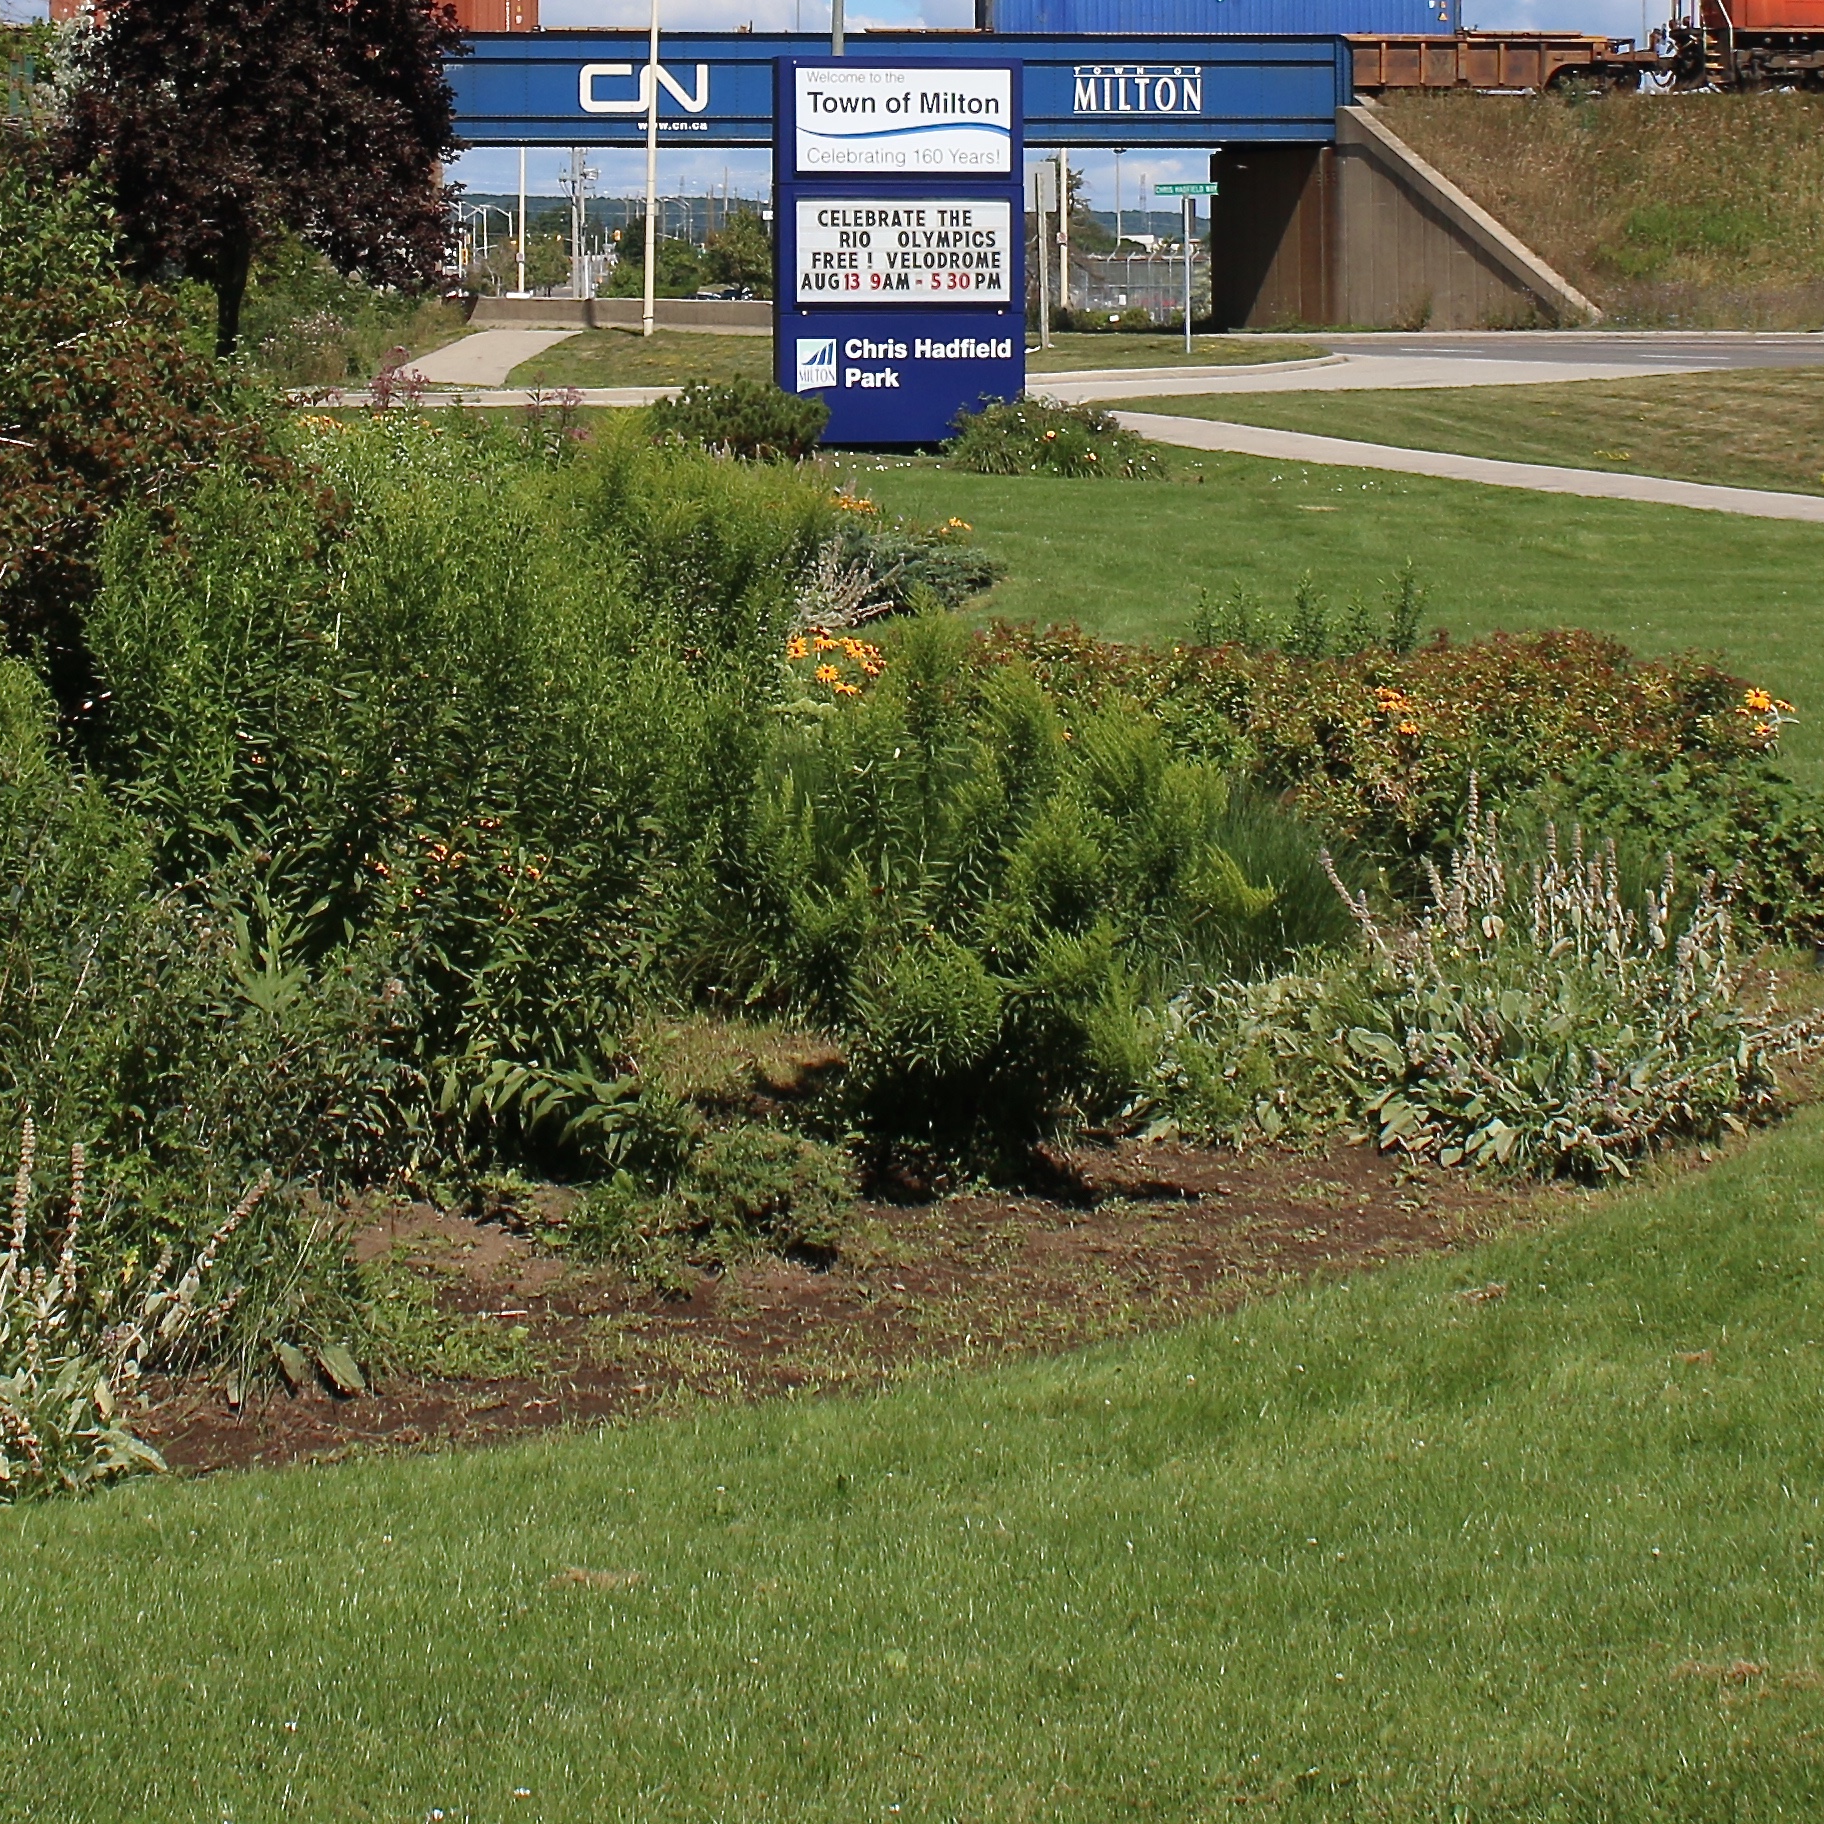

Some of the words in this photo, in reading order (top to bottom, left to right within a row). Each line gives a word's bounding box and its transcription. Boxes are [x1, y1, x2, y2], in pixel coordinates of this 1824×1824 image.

[807, 71, 866, 84] Welcome
[869, 72, 882, 84] to
[885, 72, 905, 84] the
[1073, 66, 1144, 75] TOWN
[1173, 66, 1202, 75] OF
[579, 63, 709, 113] CN
[1073, 77, 1202, 112] MILTON
[807, 91, 876, 114] Town
[885, 91, 911, 114] of
[920, 92, 1000, 114] Milton
[637, 122, 708, 131] ww.cn.ca
[806, 147, 906, 167] Celebrating
[914, 149, 944, 165] 160
[948, 148, 1000, 165] Years!
[817, 209, 926, 227] CELEBRATE
[937, 209, 973, 227] THE
[839, 230, 871, 248] RIO
[897, 230, 996, 248] OLYMPICS
[811, 251, 859, 269] FREE
[886, 251, 1001, 269] VELODROME
[801, 272, 840, 290] AUG
[843, 272, 861, 291] 13
[870, 272, 911, 291] 9AM
[975, 273, 1002, 291] PM
[844, 338, 908, 360] Chris
[914, 338, 1012, 360] Hadfield
[798, 367, 836, 383] MILTON
[844, 367, 900, 389] Park
